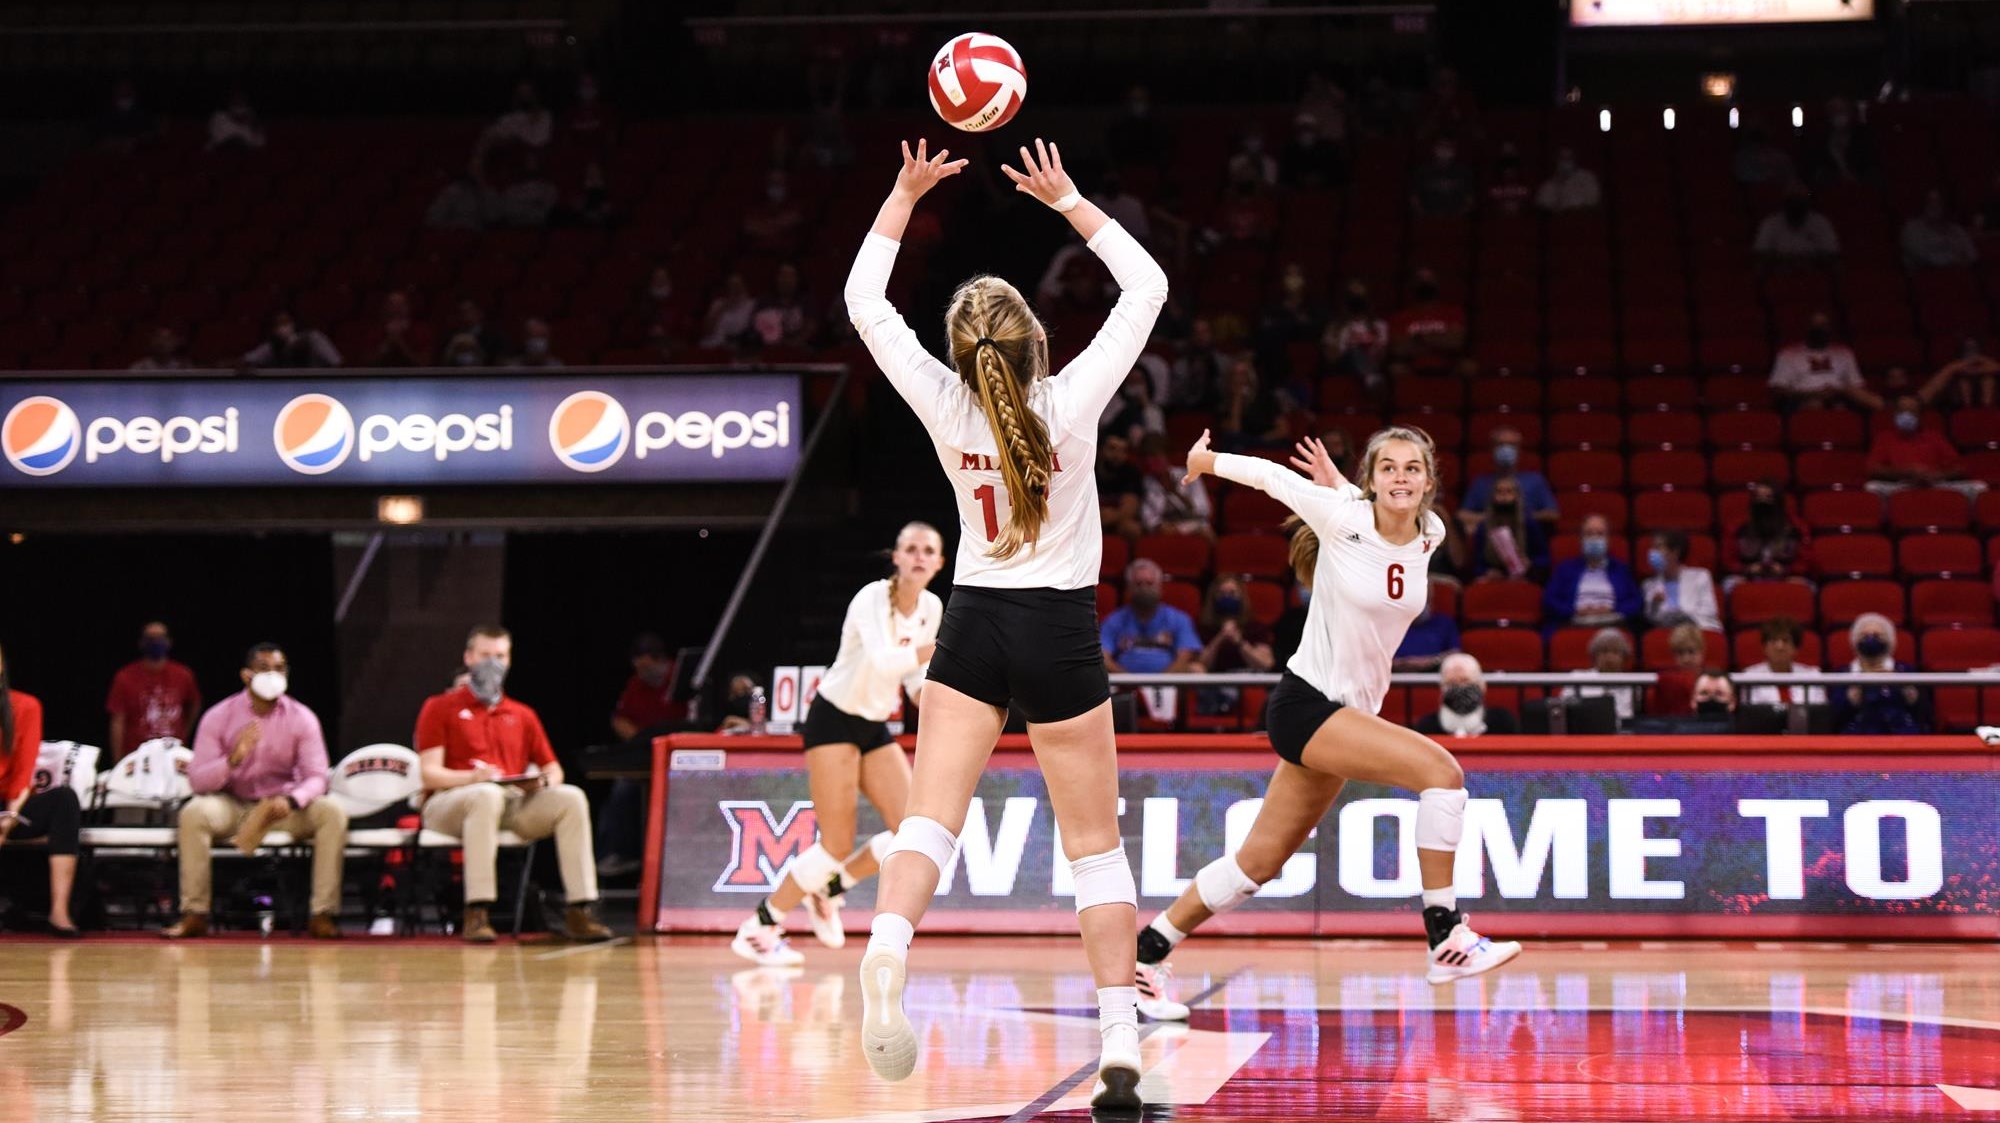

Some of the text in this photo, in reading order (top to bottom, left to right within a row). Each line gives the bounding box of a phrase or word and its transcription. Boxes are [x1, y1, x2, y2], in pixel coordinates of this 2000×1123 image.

[86, 407, 239, 463] pepsi
[358, 404, 513, 461] pepsi
[635, 401, 790, 459] pepsi
[960, 451, 1063, 472] MII
[1387, 563, 1405, 600] 6
[711, 800, 821, 893] M
[1737, 798, 1943, 900] TO
